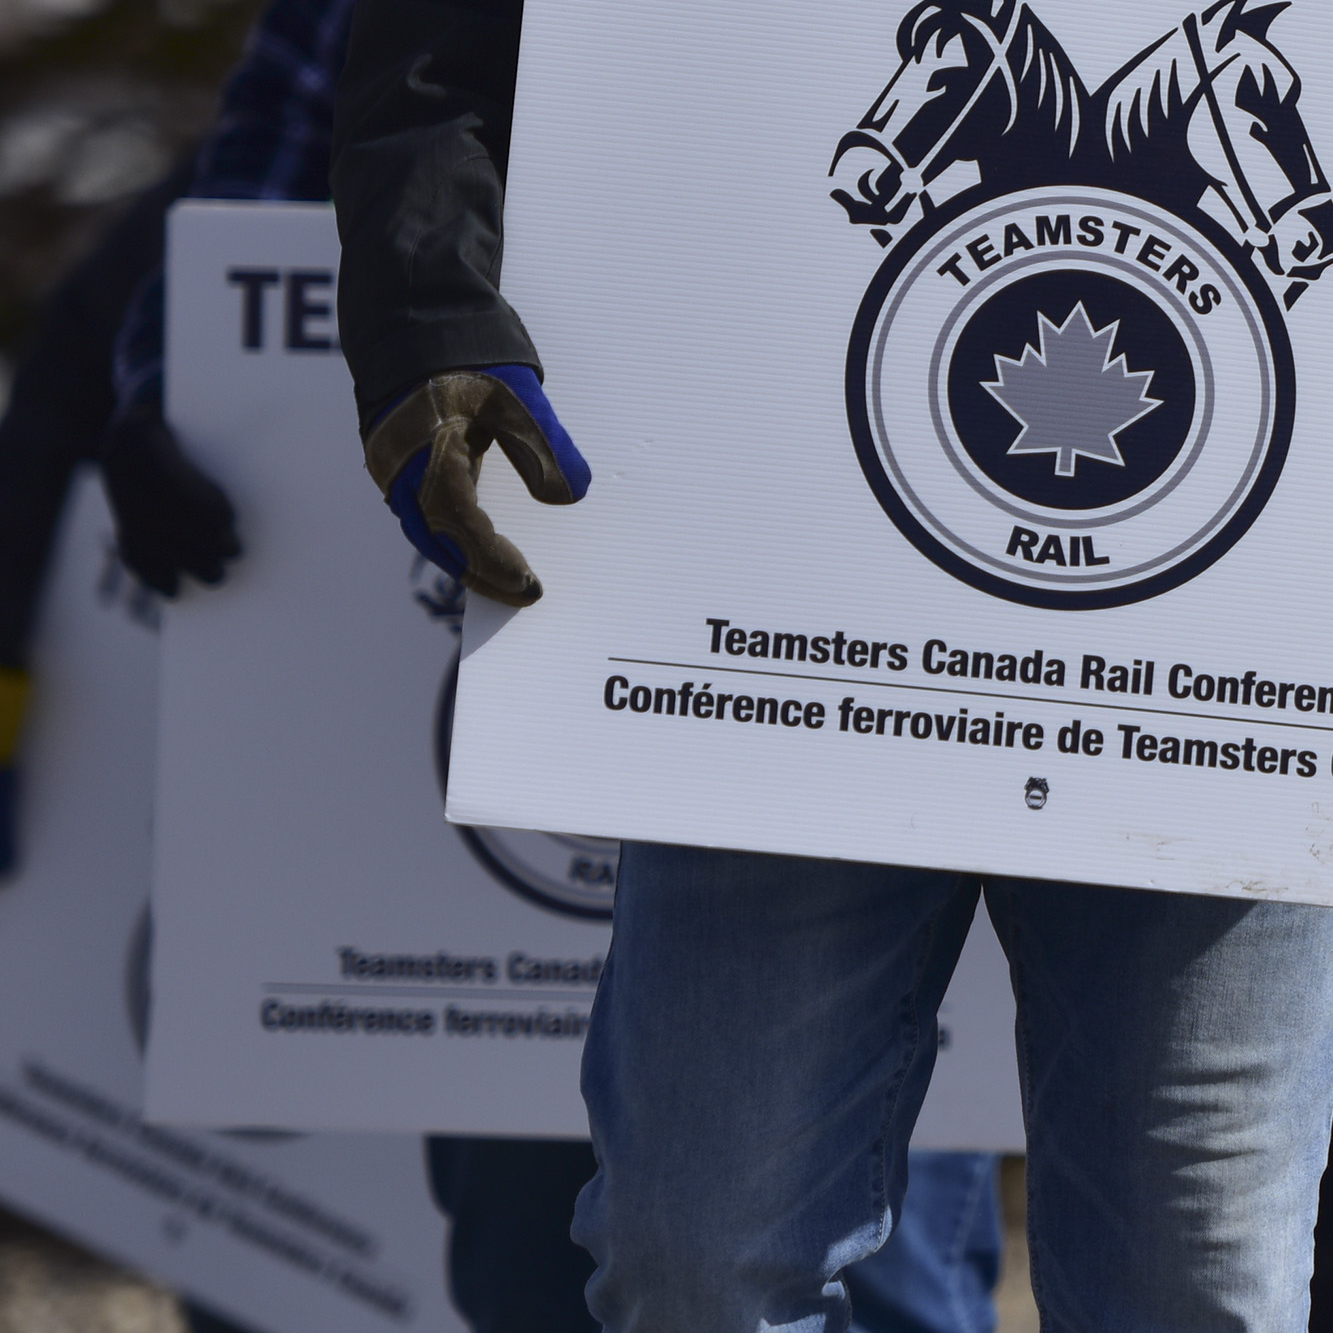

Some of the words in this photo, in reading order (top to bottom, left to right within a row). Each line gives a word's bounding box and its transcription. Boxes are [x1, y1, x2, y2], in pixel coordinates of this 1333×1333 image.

[936, 214, 1222, 316] TEAMSTERS
[1005, 525, 1110, 567] RAIL
[705, 618, 908, 671] Teamsters
[922, 639, 1065, 687] Canada
[1080, 654, 1155, 695] Rail
[603, 675, 826, 729] Conférence
[838, 696, 1045, 750] ferroviaire
[1057, 720, 1104, 756] de
[1117, 724, 1318, 777] Teamsters
[567, 854, 615, 885] RA
[338, 946, 496, 984] Teamsters
[507, 951, 604, 985] Canad
